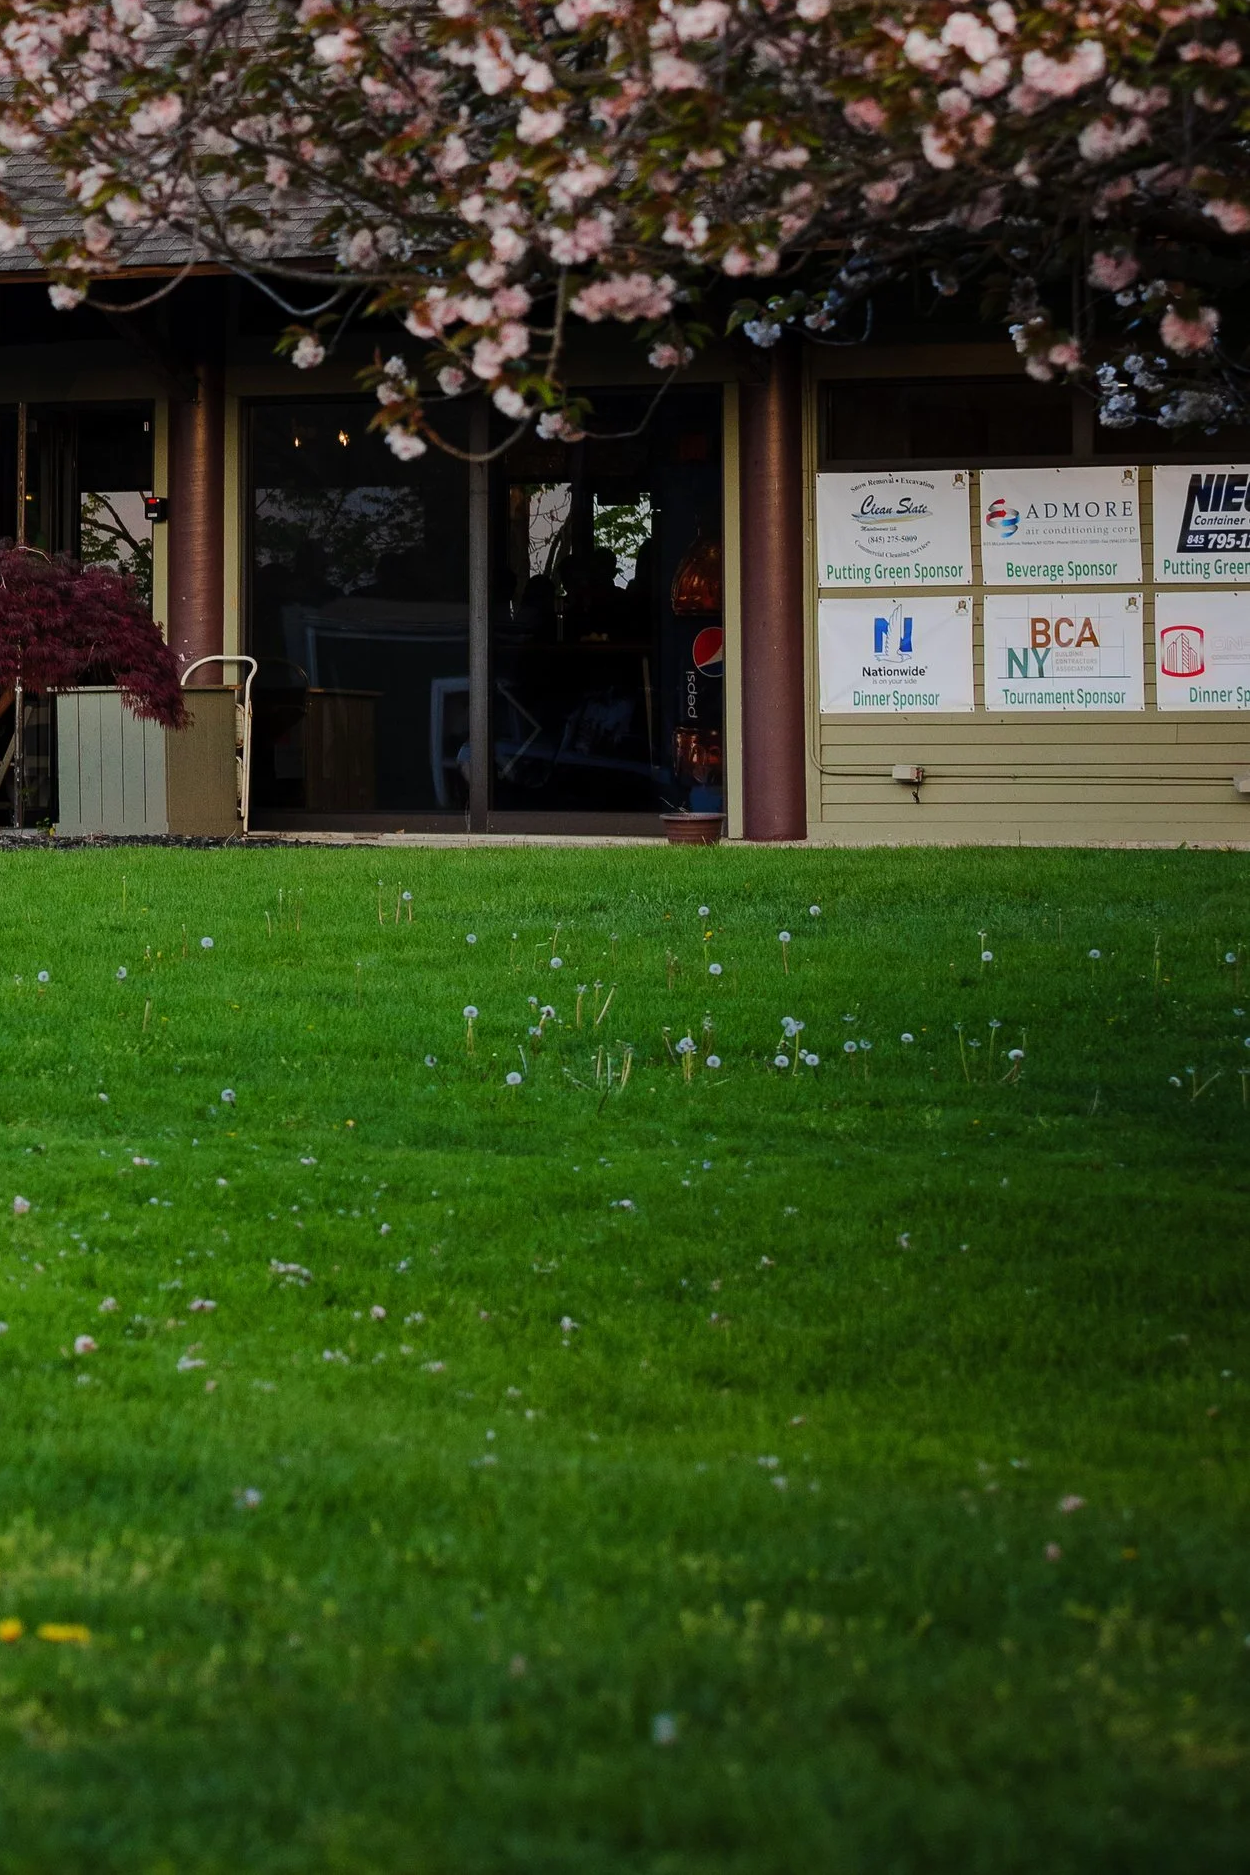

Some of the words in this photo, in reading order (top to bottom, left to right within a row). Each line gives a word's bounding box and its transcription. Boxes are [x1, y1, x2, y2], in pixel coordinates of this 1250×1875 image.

[867, 477, 894, 486] Removal
[900, 477, 935, 490] Excavation
[860, 494, 892, 515] Clean
[896, 497, 927, 514] Slate
[1026, 501, 1133, 519] ADMORE
[1026, 527, 1039, 535] air
[1043, 525, 1109, 535] conditioning
[1112, 526, 1136, 535] corp
[1194, 515, 1245, 526] Container
[867, 536, 885, 544] (845)
[1186, 535, 1204, 544] 845
[827, 564, 871, 584] Putting
[874, 564, 910, 579] Green
[914, 563, 963, 582] Sponsor
[1006, 562, 1064, 581] Beverage
[1067, 561, 1118, 580] Sponsor
[1164, 559, 1210, 579] Putting
[1031, 617, 1100, 648] BCA
[1008, 648, 1051, 678] NY
[686, 670, 698, 718] pepsi
[853, 690, 891, 706] Dinner
[892, 690, 940, 709] Sponsor
[1003, 689, 1075, 704] Tournament
[1077, 688, 1126, 707] Sponsor
[1190, 686, 1232, 703] Dinner
